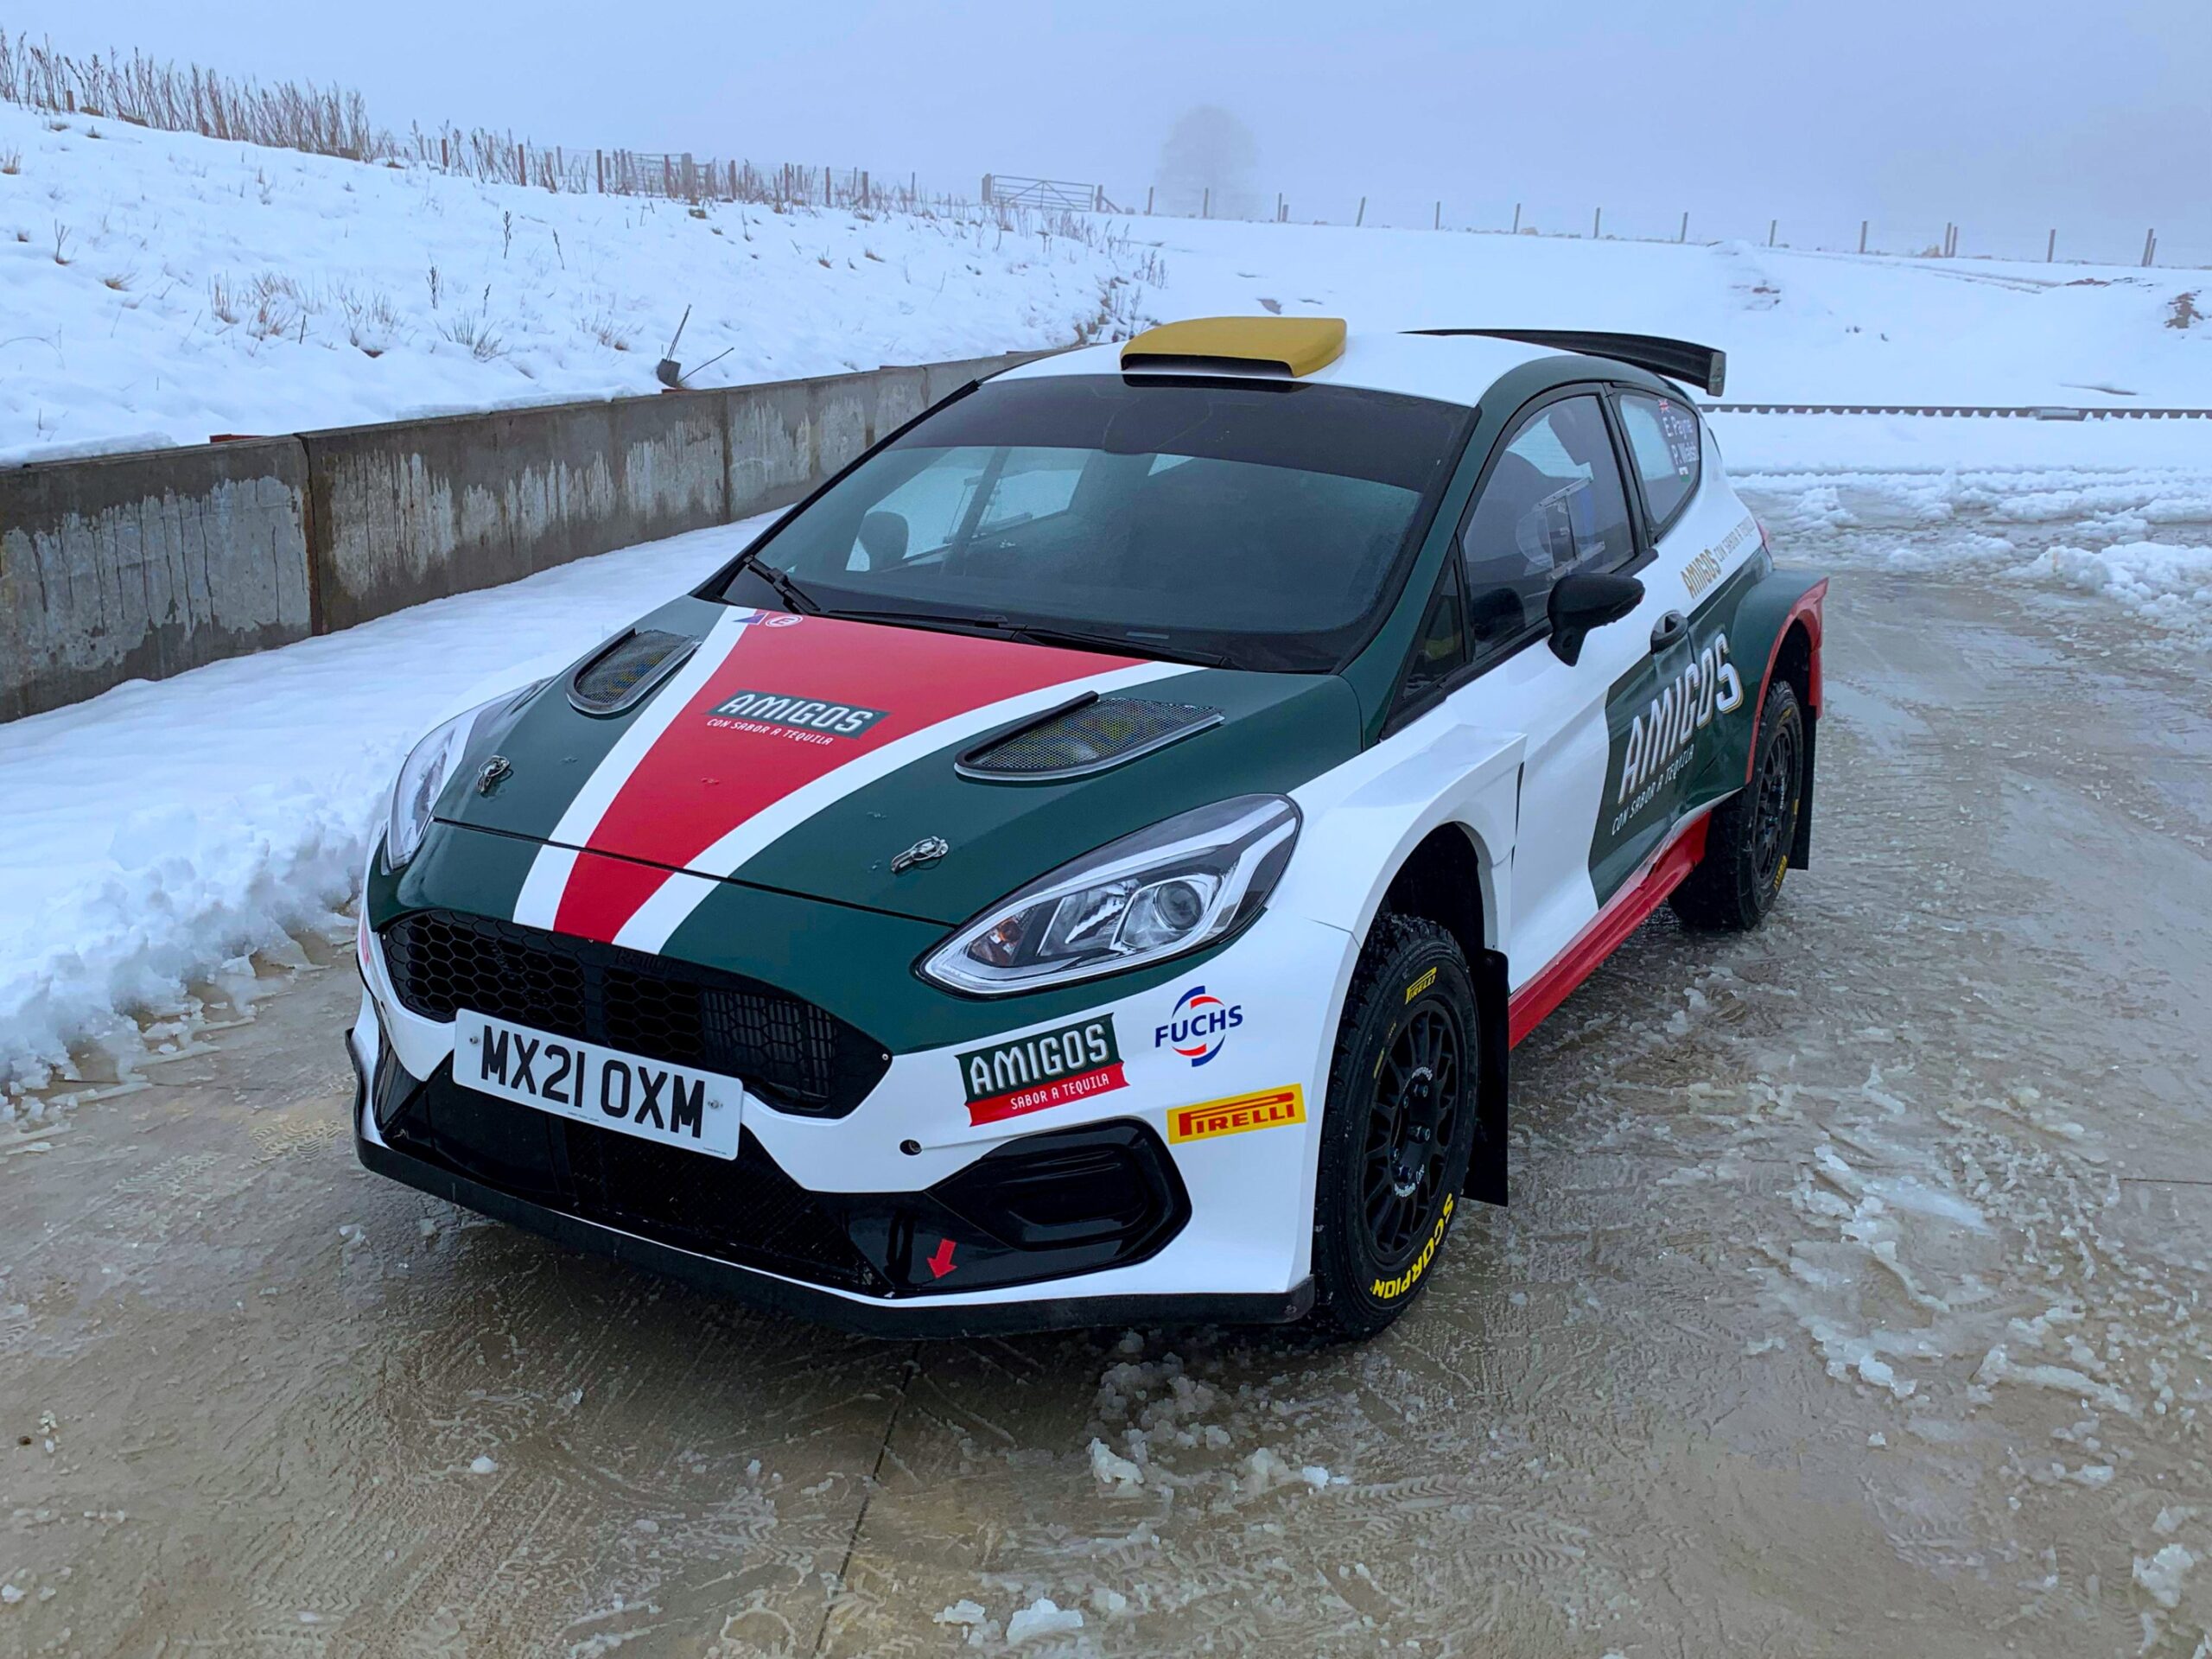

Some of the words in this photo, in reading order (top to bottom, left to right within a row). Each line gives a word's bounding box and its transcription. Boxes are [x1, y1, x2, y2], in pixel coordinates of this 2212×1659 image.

[1681, 549, 1722, 599] AMIGOS
[707, 718, 730, 728] CON
[731, 721, 771, 735] SABOR
[771, 727, 782, 736] A
[783, 729, 834, 747] TEQUILA
[717, 693, 874, 734] AMIGOS
[1618, 632, 1744, 804] AMIGOS
[1611, 806, 1630, 836] CON
[1404, 966, 1437, 1005] PIRELLI
[1154, 1004, 1243, 1048] FUCHS
[969, 1023, 1109, 1095] AMIGOS
[480, 1025, 585, 1109] MX21
[600, 1059, 706, 1139] OXM
[1010, 1090, 1048, 1109] SABOR
[1052, 1086, 1060, 1099] A
[1063, 1072, 1110, 1096] TEQUILA
[1178, 1091, 1295, 1137] PIRELLI
[1372, 1192, 1454, 1299] SCORPION
